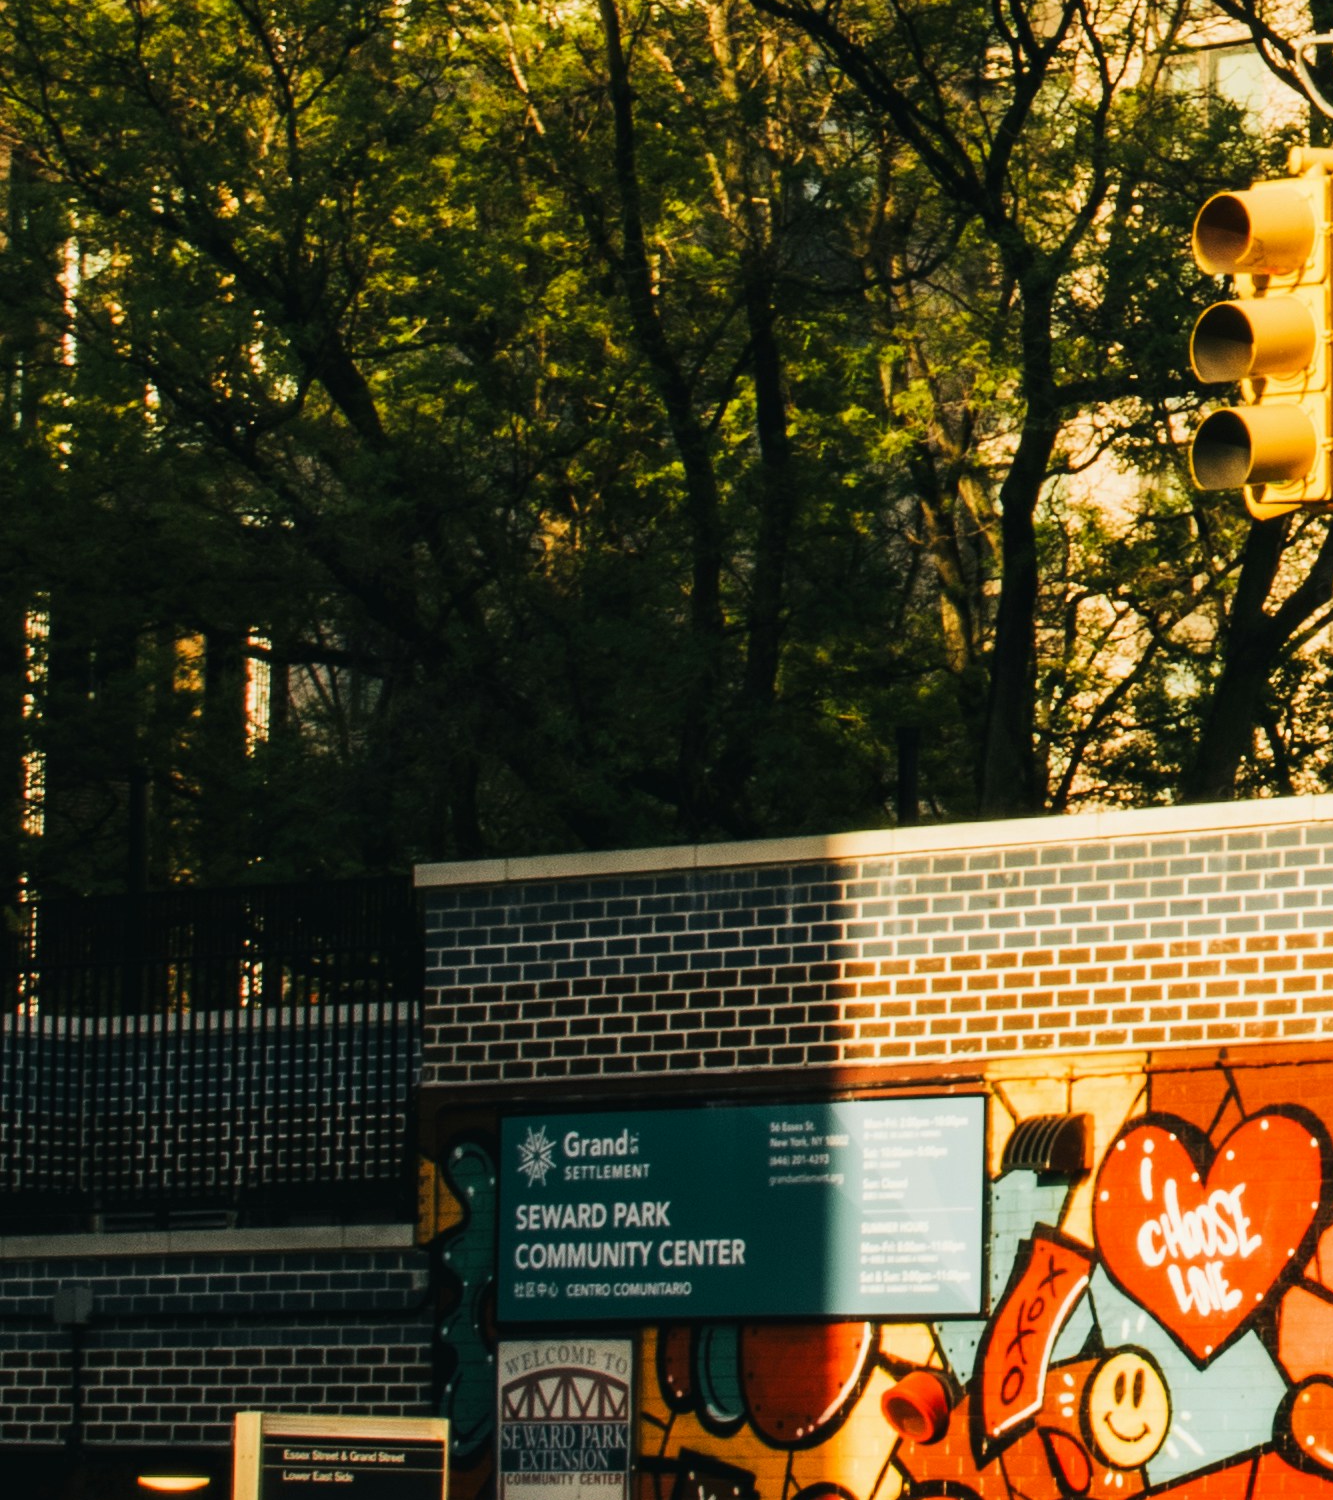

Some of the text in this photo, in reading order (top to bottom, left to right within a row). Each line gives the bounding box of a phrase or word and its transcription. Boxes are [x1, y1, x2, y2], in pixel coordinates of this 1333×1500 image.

[563, 1127, 628, 1158] Grand
[563, 1163, 650, 1181] SETTLEMENT
[515, 1200, 671, 1231] SEWARD PARK
[514, 1238, 747, 1270] COMMUNITY CENTER
[565, 1280, 692, 1298] CENTRO COMUNITARIO
[1166, 1260, 1244, 1318] LOVE
[505, 1344, 628, 1376] WELCOME TO
[502, 1424, 627, 1450] SEWARD PARK
[283, 1448, 310, 1460] Essex
[312, 1449, 339, 1461] Street
[349, 1450, 377, 1462] Grand
[378, 1451, 406, 1463] Street
[519, 1449, 610, 1471] EXTENSION
[282, 1470, 355, 1483] Lower East Side
[506, 1472, 624, 1486] COMMUNITY CENTER
